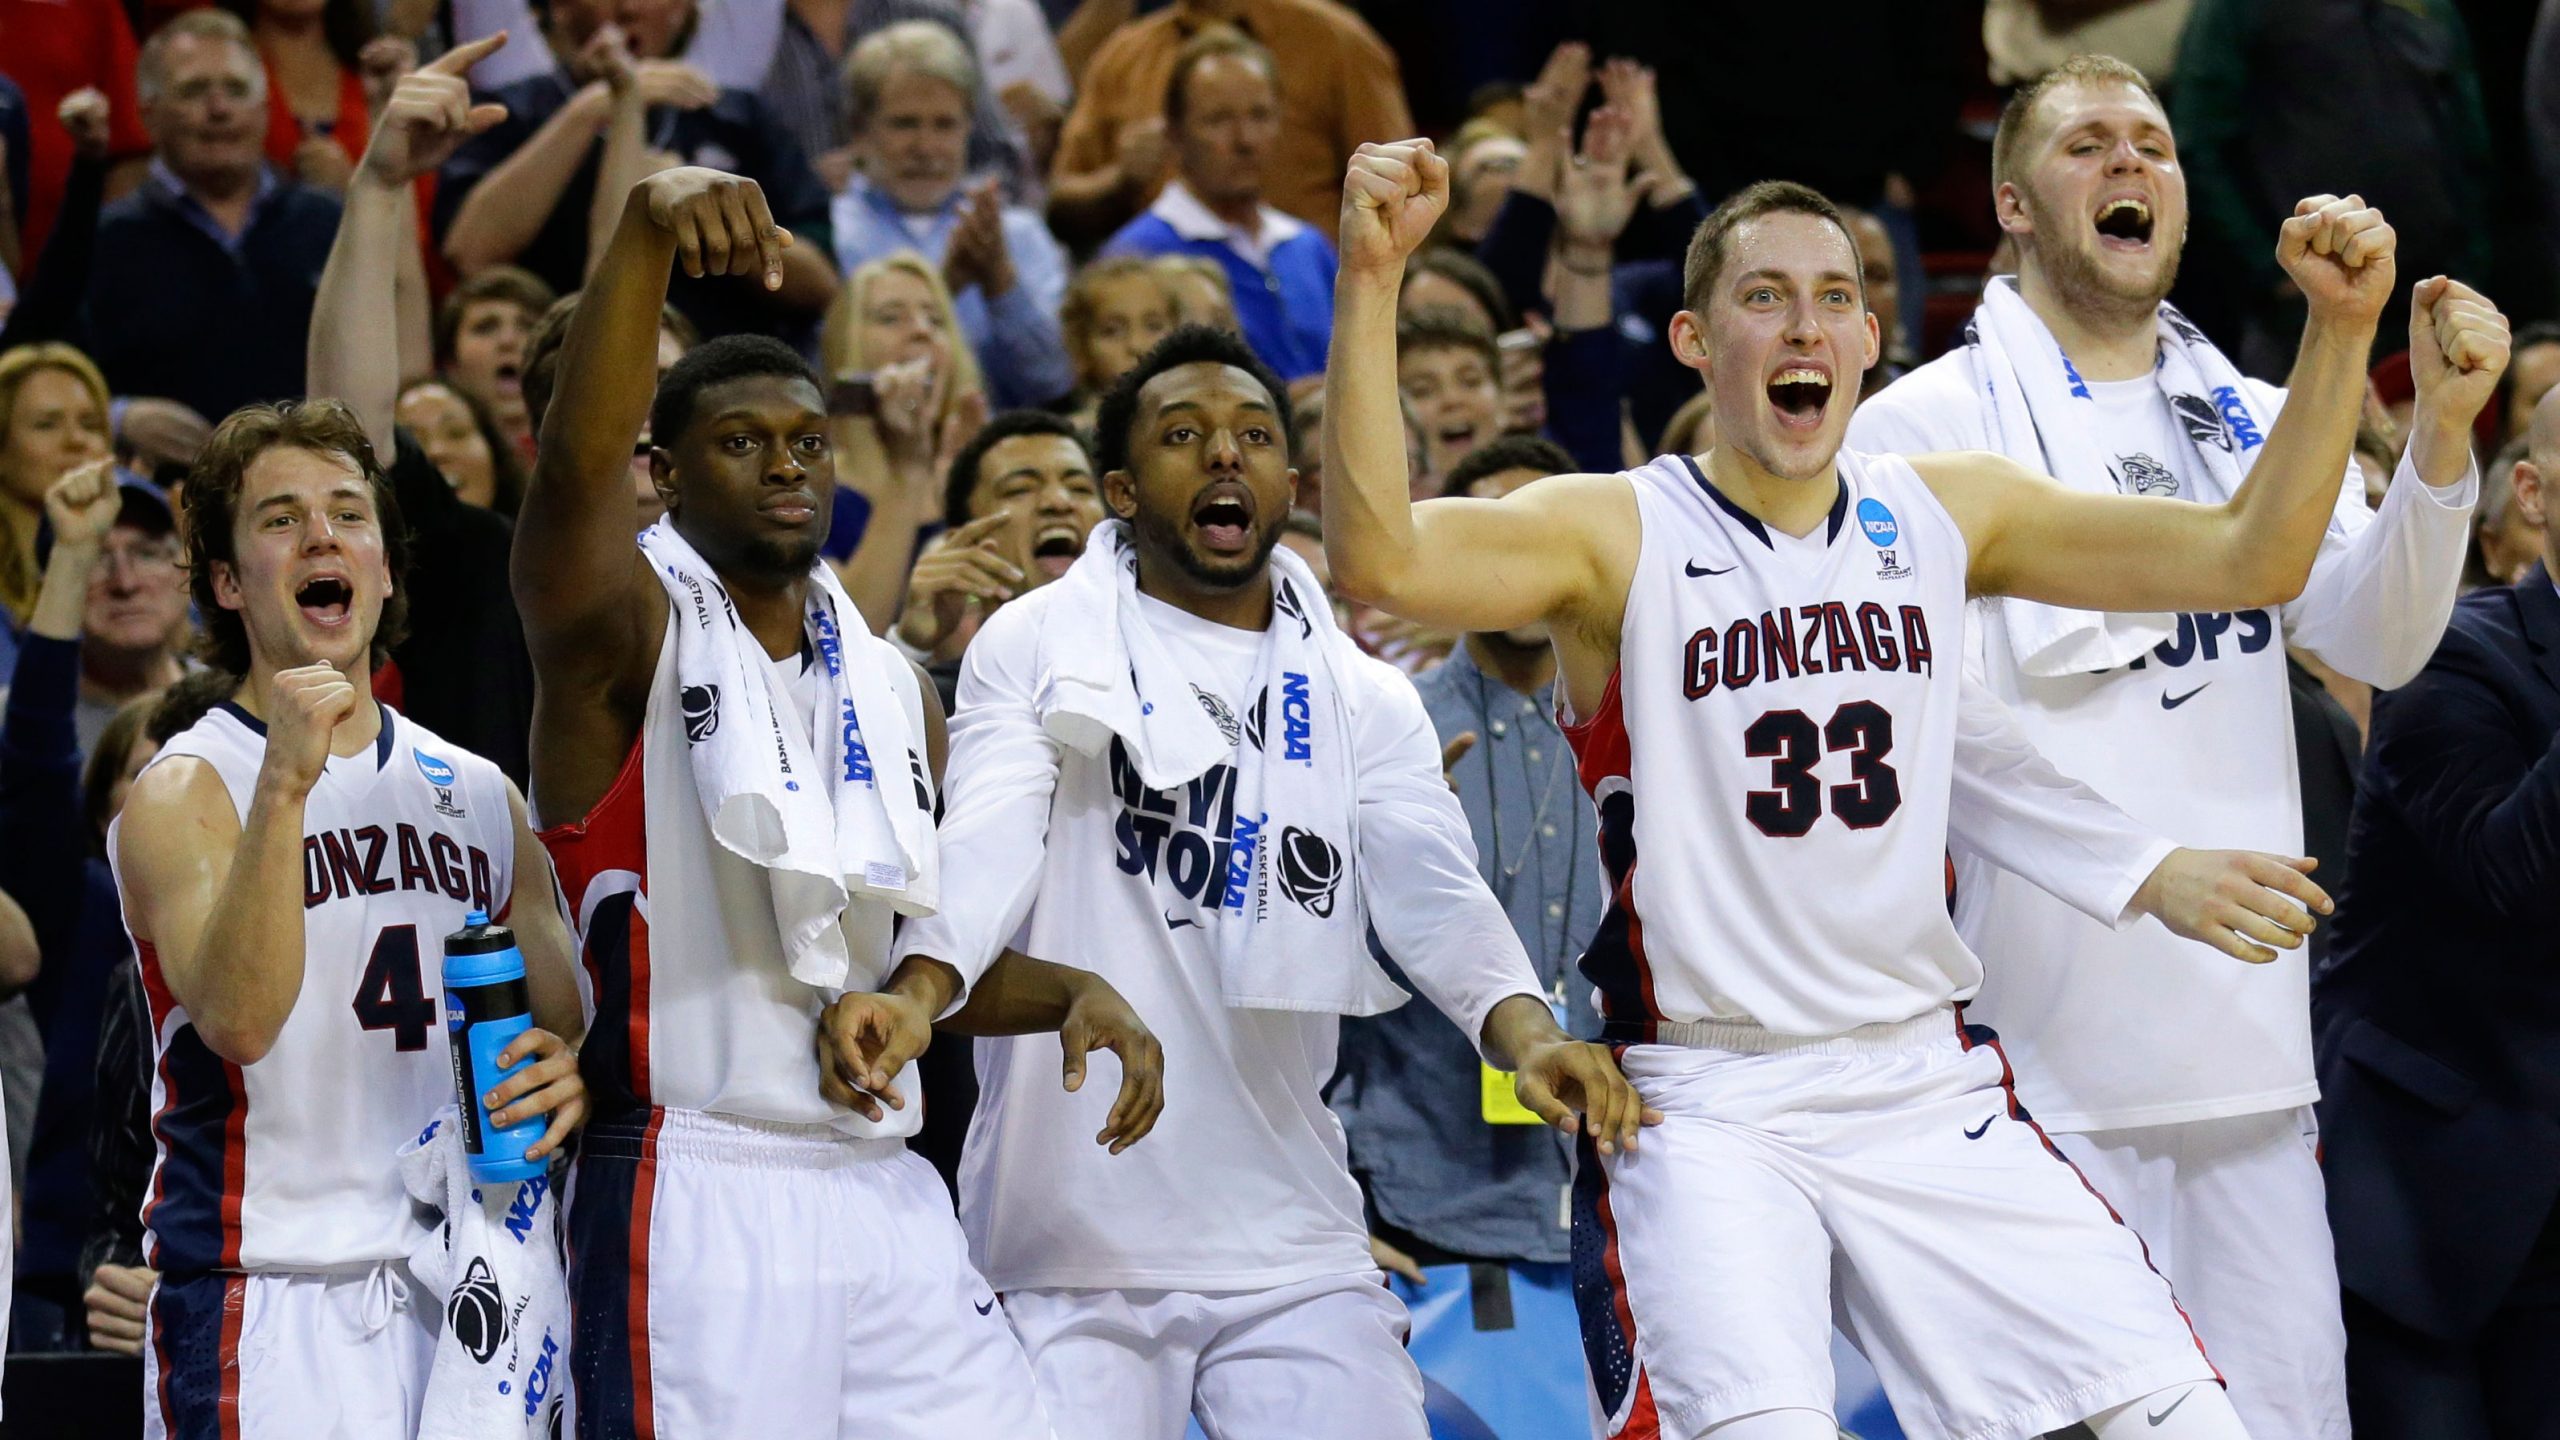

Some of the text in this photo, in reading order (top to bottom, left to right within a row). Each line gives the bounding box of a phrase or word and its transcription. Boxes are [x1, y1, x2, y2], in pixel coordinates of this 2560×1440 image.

[2212, 385, 2264, 452] NCAA
[1864, 520, 1897, 534] NCAA
[1683, 601, 1932, 702] GONZAGA
[2088, 608, 2272, 674] OPS
[843, 698, 873, 782] NCAA
[1283, 671, 1311, 760] NCAA
[1109, 732, 1238, 838] NEV
[1744, 700, 1901, 837] 33
[304, 823, 493, 921] ONZAGA
[1115, 806, 1232, 909] STO
[1223, 814, 1259, 908] NCAA
[1257, 834, 1268, 923] BASKETBALL
[353, 924, 437, 1051] 4
[446, 1010, 465, 1021] CAA
[452, 1043, 472, 1143] POWERADE
[505, 1173, 549, 1244] NCA
